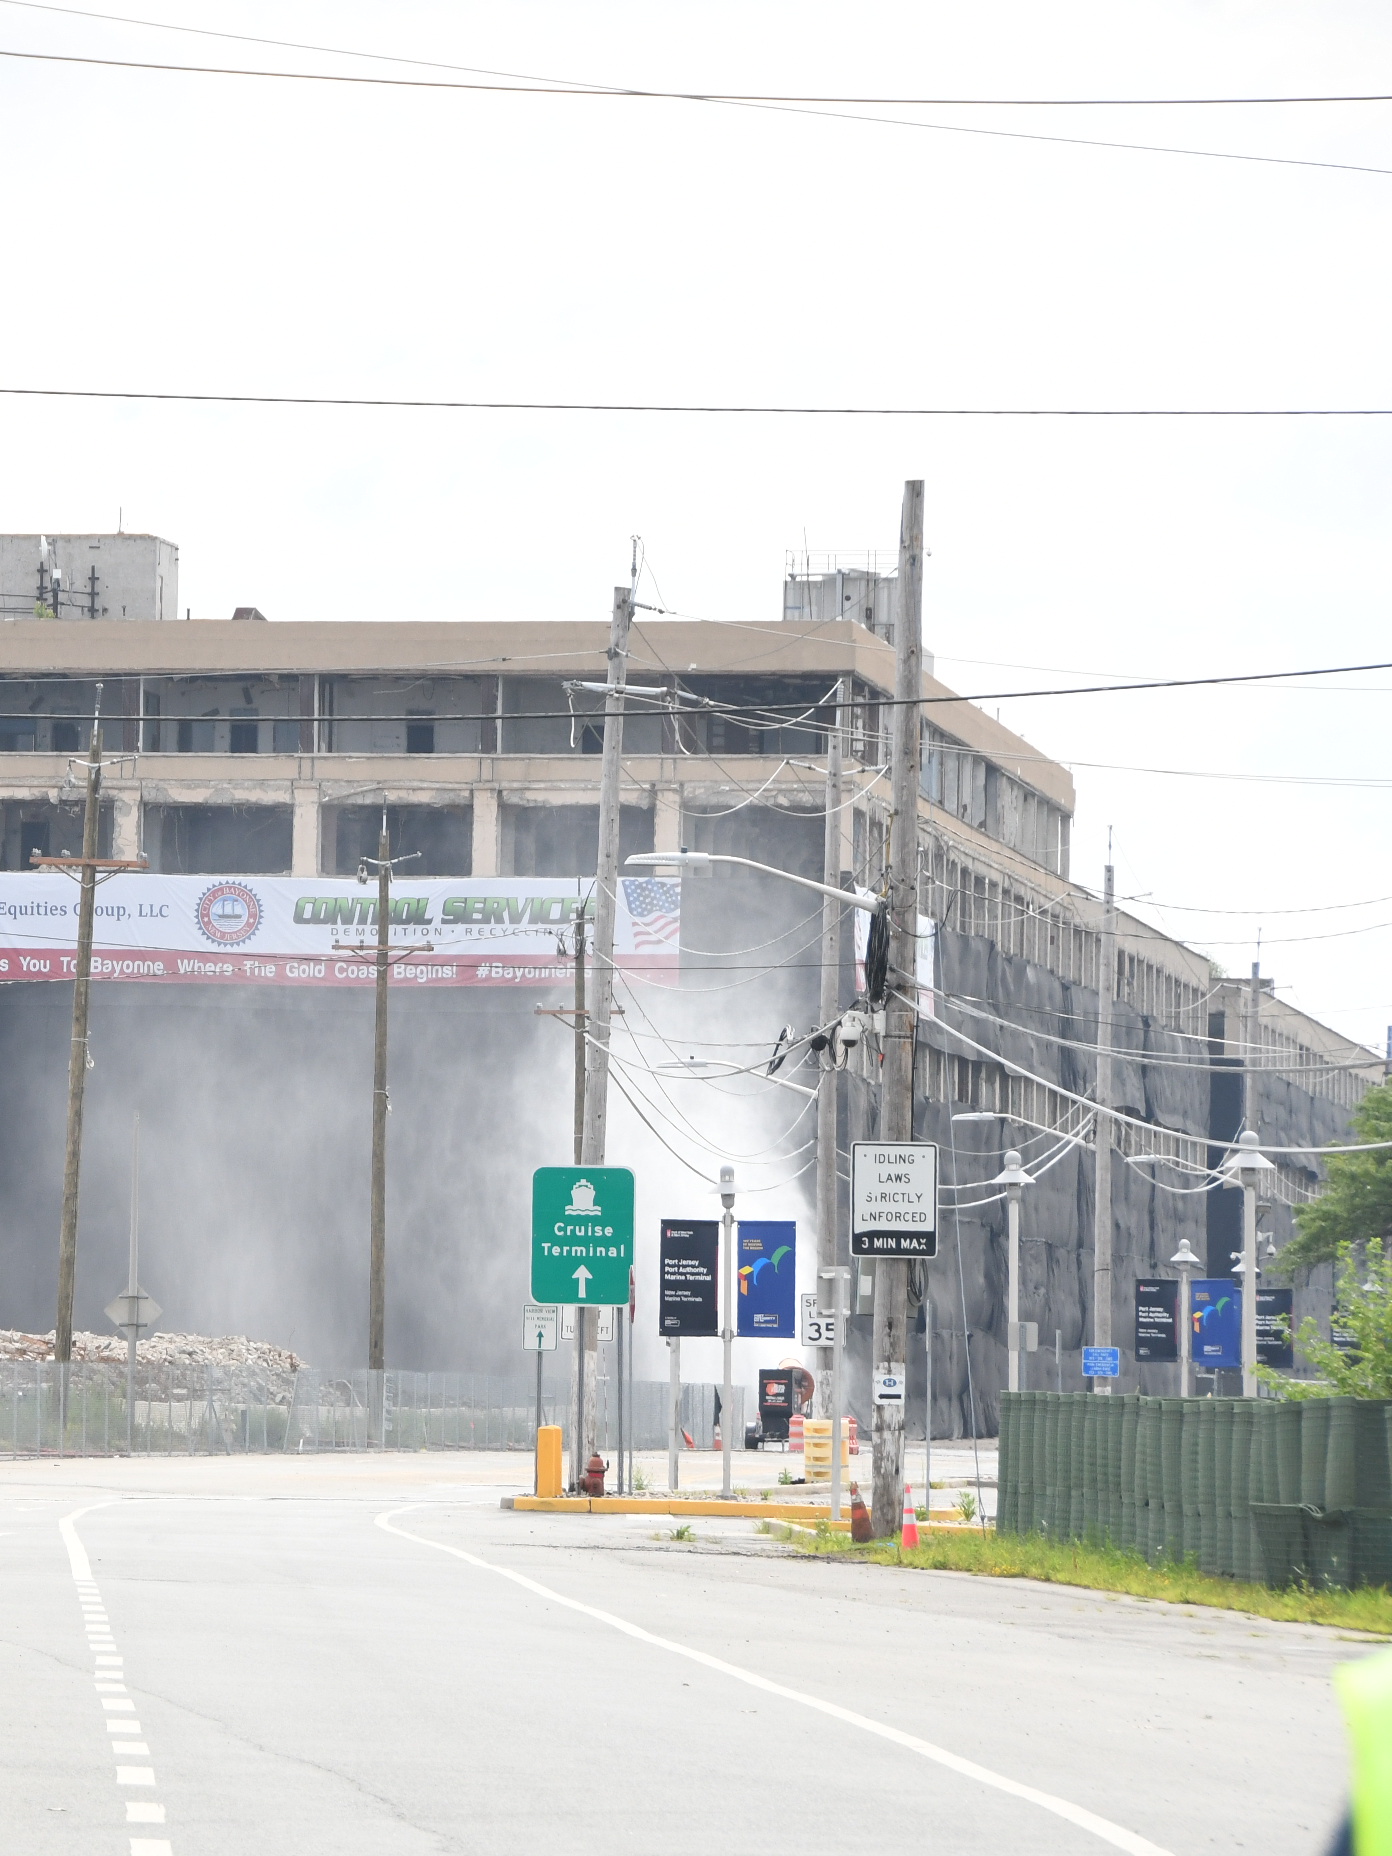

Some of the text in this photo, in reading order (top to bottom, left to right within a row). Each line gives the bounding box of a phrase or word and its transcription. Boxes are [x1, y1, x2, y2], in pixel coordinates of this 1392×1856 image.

[202, 894, 214, 914] CITY
[223, 886, 257, 914] BAYONNE
[73, 902, 131, 921] Goup,
[138, 903, 169, 918] LLC
[293, 896, 434, 926] CONTROL
[206, 924, 250, 940] NEW JERSEY
[330, 927, 565, 937] DEMOITION RECYCLING
[20, 956, 50, 972] You
[177, 959, 233, 976] Where
[244, 960, 276, 977] The
[286, 962, 325, 978] Gold
[334, 963, 378, 978] Coas
[394, 963, 457, 982] Begins!
[874, 1154, 914, 1164] IDLING
[878, 1173, 910, 1184] LAWS
[554, 1222, 614, 1236] Cruise
[542, 1242, 624, 1257] Terminal
[862, 1237, 926, 1250] 3 MIN MAX
[808, 1322, 834, 1342] 35
